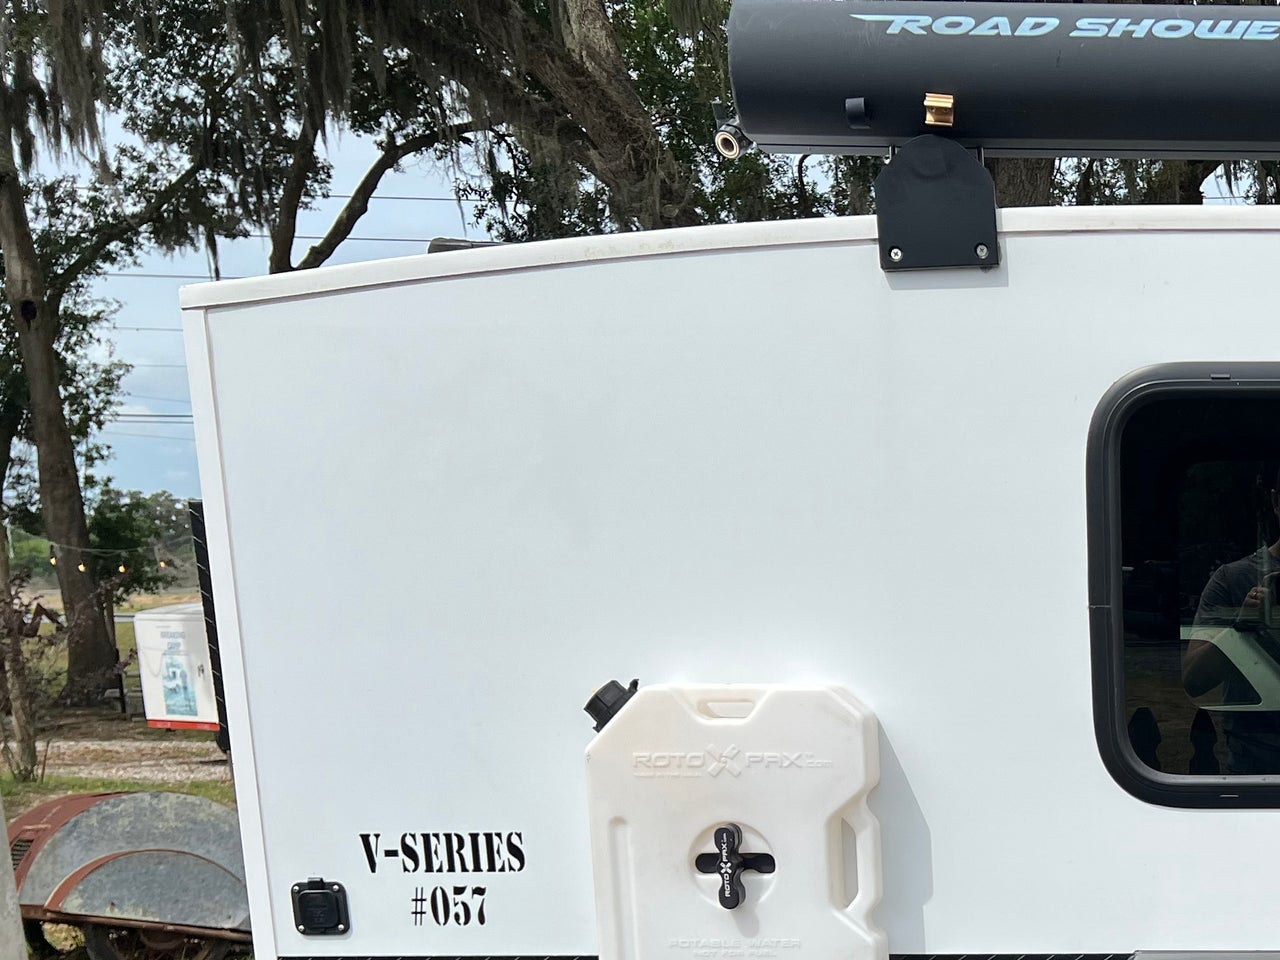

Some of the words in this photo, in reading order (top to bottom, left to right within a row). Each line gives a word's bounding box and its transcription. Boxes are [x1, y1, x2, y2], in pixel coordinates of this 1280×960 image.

[853, 14, 1060, 37] ROAD
[633, 751, 704, 768] ROTO
[359, 831, 526, 873] V-SERIES
[411, 886, 488, 926] #057
